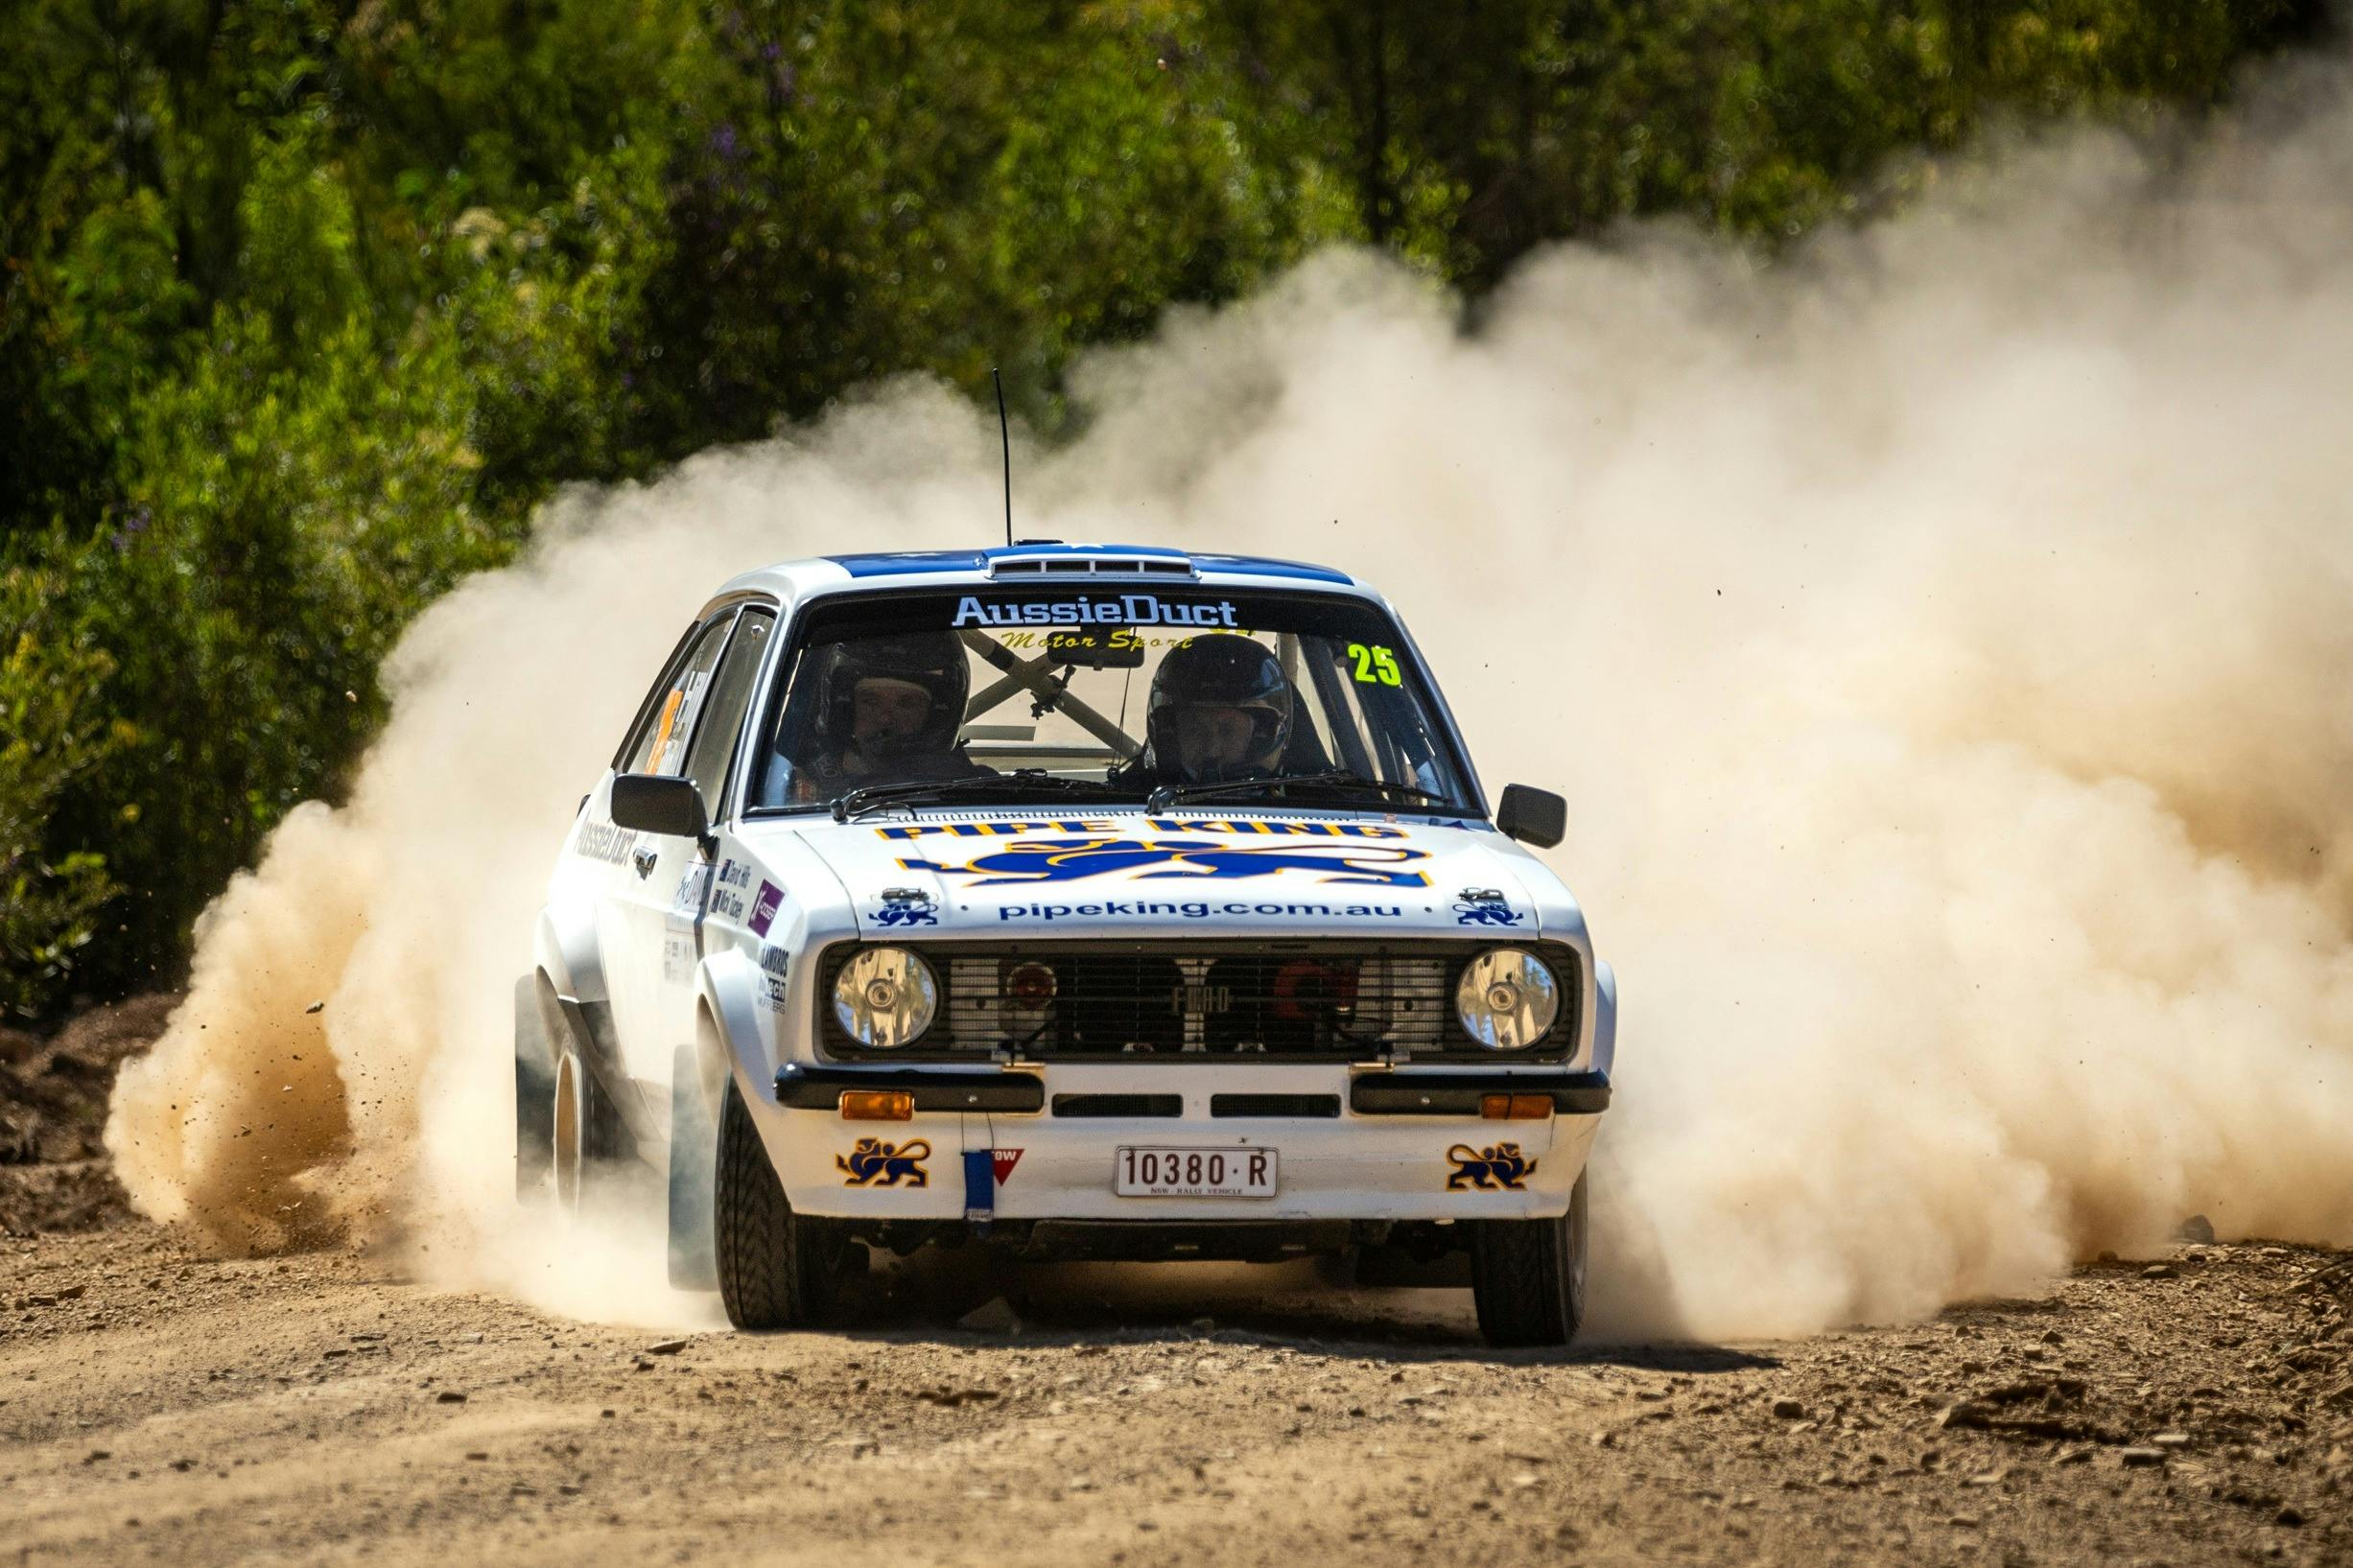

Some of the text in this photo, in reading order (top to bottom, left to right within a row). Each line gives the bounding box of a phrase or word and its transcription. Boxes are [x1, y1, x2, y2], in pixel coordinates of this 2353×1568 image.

[952, 595, 1238, 627] AussieDuct
[1000, 630, 1097, 649] Motor
[1108, 629, 1195, 652] Sport
[1348, 644, 1401, 687] 25
[875, 819, 1412, 841] PIPE KING
[999, 901, 1402, 921] pipeking.com.au
[991, 1150, 1018, 1161] OW
